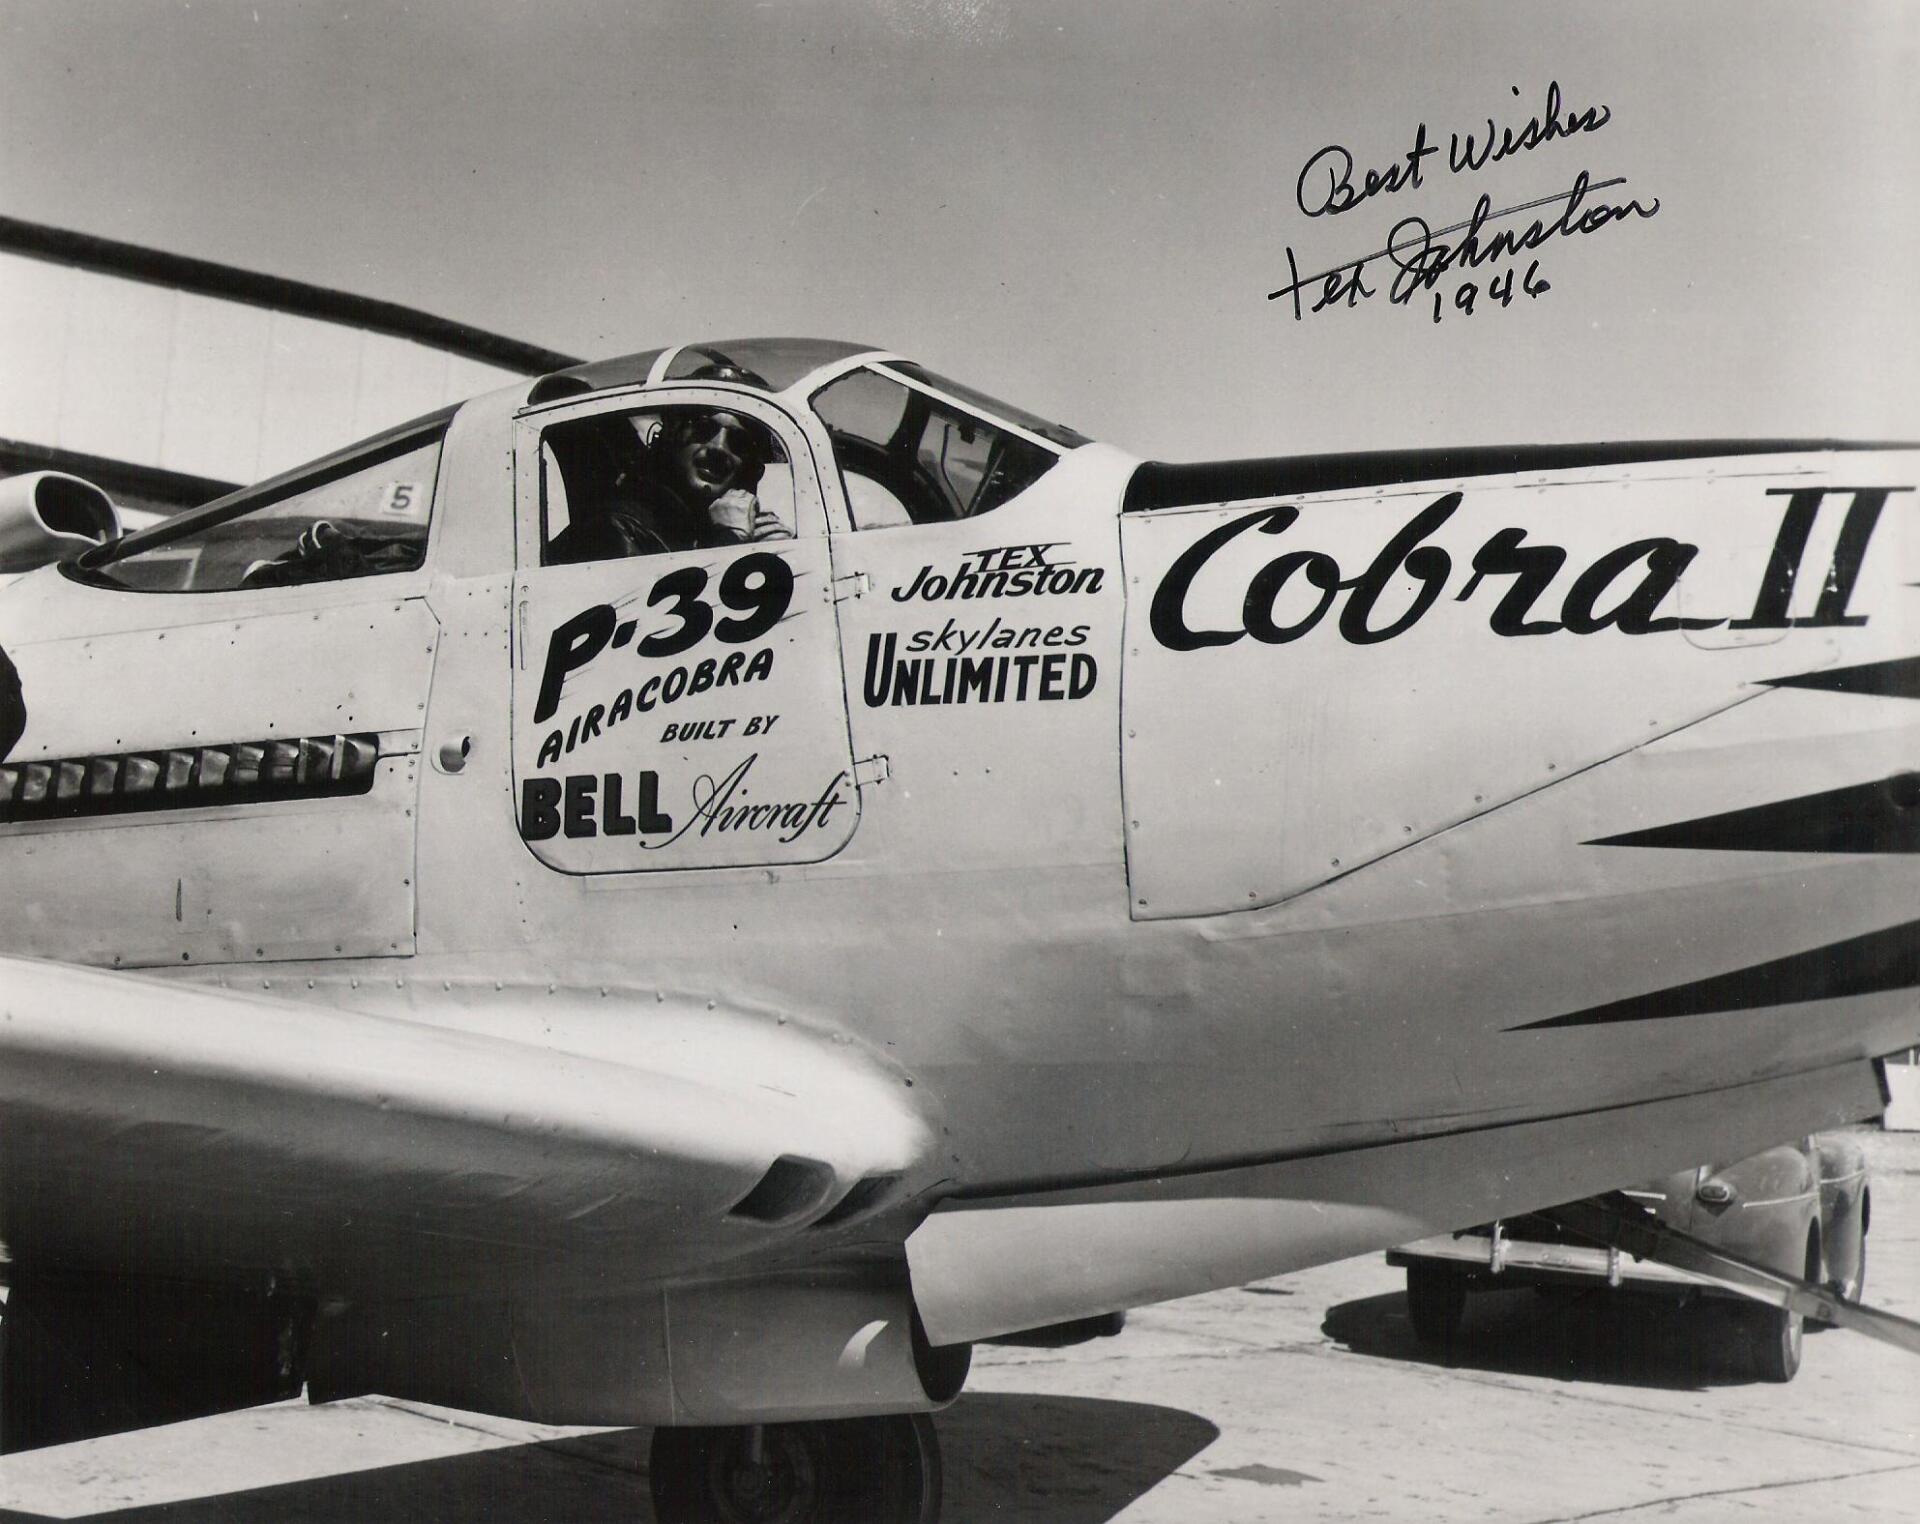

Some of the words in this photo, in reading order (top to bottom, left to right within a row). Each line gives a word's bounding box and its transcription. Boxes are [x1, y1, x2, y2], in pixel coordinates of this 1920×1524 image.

[391, 485, 412, 511] 5
[976, 543, 1053, 573] TEX
[1149, 491, 1727, 651] Cobra
[1729, 485, 1917, 629] II
[890, 561, 1105, 603] Johnston
[905, 617, 1091, 656] skylanes
[863, 632, 1098, 708] UNLIMITED
[536, 647, 774, 769] AIRACOBRA
[660, 718, 738, 743] BUILT
[743, 715, 780, 737] BY
[521, 770, 673, 842] BELL
[639, 752, 848, 850] Aircraft
